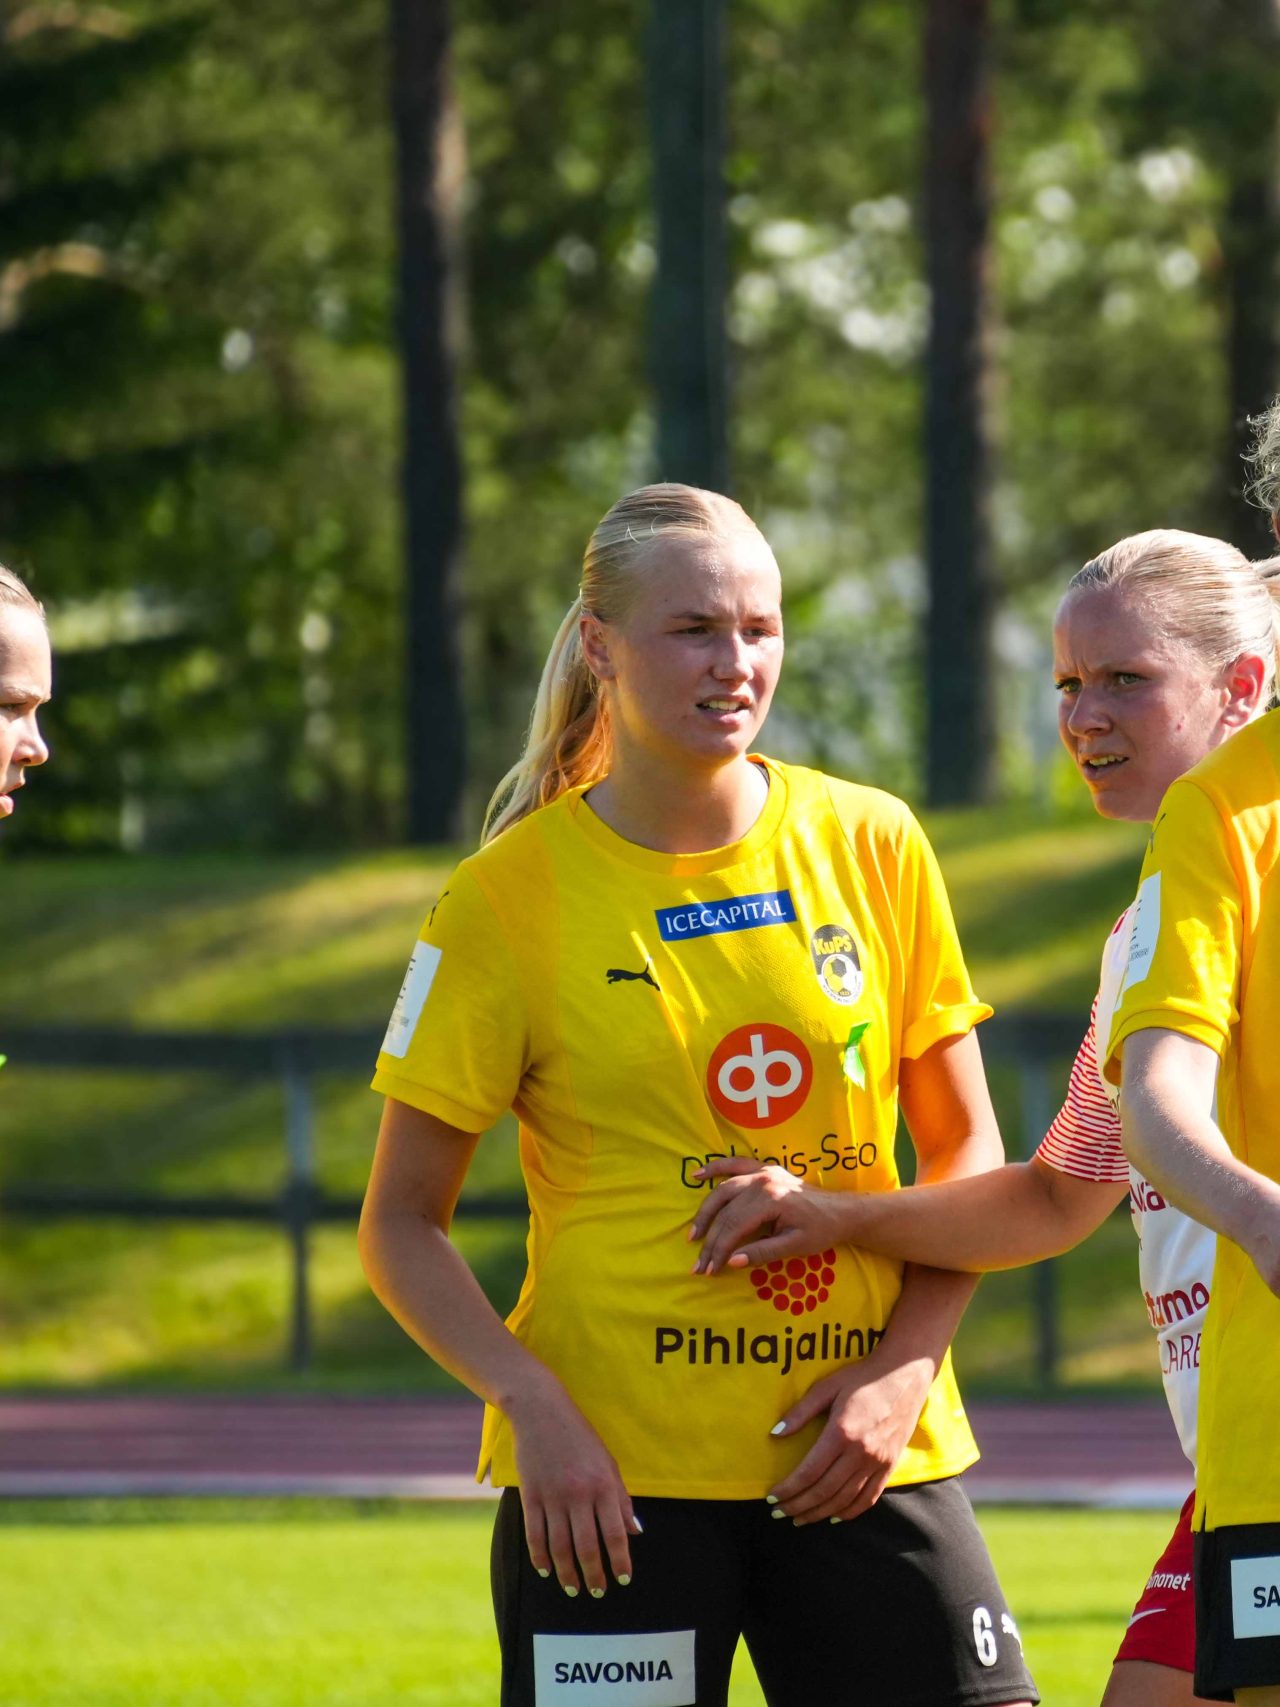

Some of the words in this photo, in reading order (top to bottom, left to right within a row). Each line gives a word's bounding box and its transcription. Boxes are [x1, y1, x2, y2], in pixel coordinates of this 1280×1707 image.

[665, 899, 787, 934] ICECAPITAL
[812, 934, 852, 956] KuPS
[1158, 1332, 1202, 1374] ARE
[972, 1606, 998, 1667] 6
[555, 1659, 674, 1684] SAVONIA
